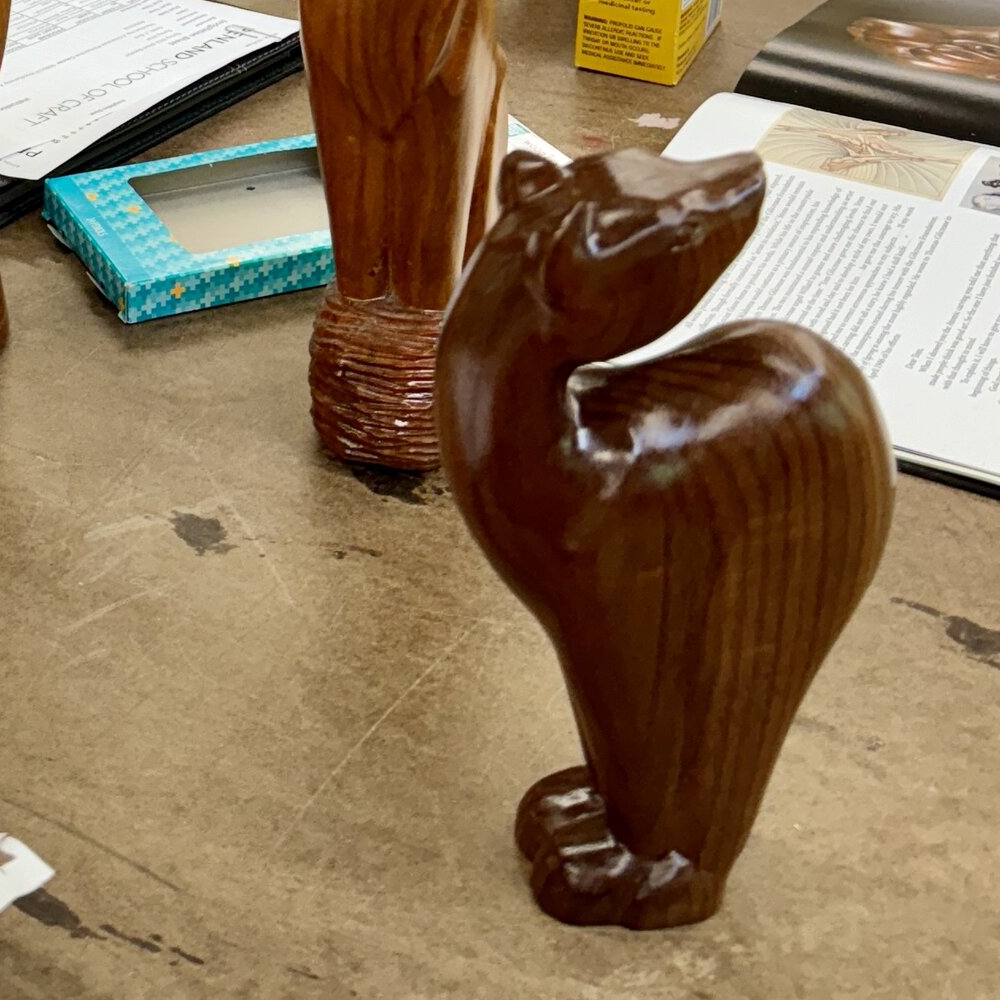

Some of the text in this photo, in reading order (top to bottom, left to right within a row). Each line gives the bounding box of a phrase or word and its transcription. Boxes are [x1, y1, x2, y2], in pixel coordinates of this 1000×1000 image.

[599, 0, 656, 15] medicinal tasting
[113, 57, 178, 87] SCHOOL
[82, 86, 109, 103] OF
[23, 98, 82, 127] CRAFT
